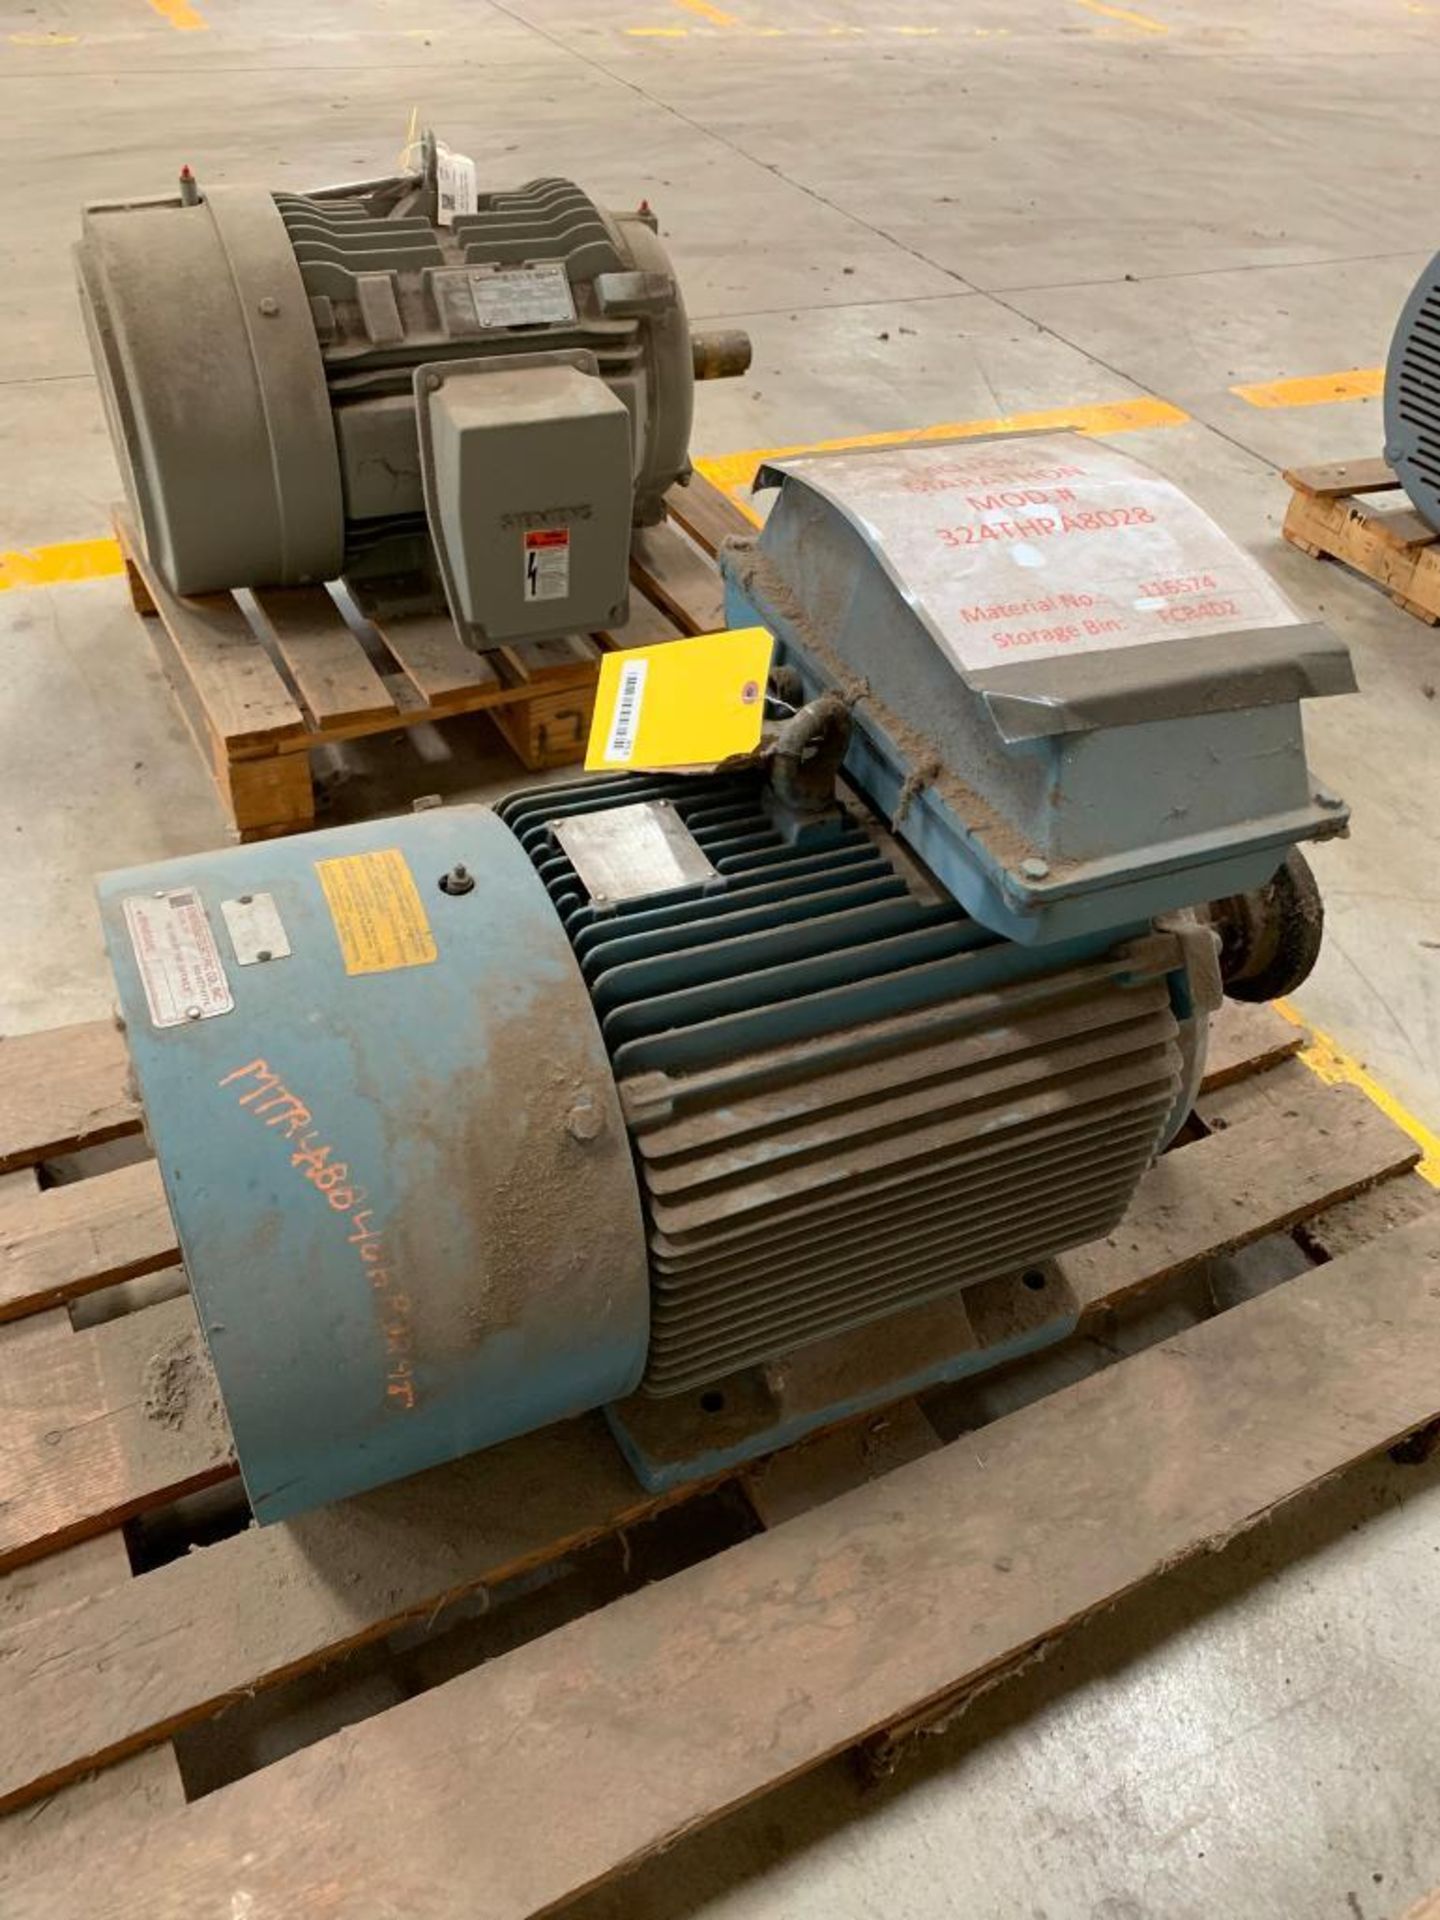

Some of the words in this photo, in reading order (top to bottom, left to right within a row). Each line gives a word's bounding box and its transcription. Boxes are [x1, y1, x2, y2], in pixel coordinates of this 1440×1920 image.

[967, 488, 1049, 511] MOD
[1055, 487, 1077, 502] #
[960, 595, 1056, 623] Material
[992, 625, 1079, 648] Storage
